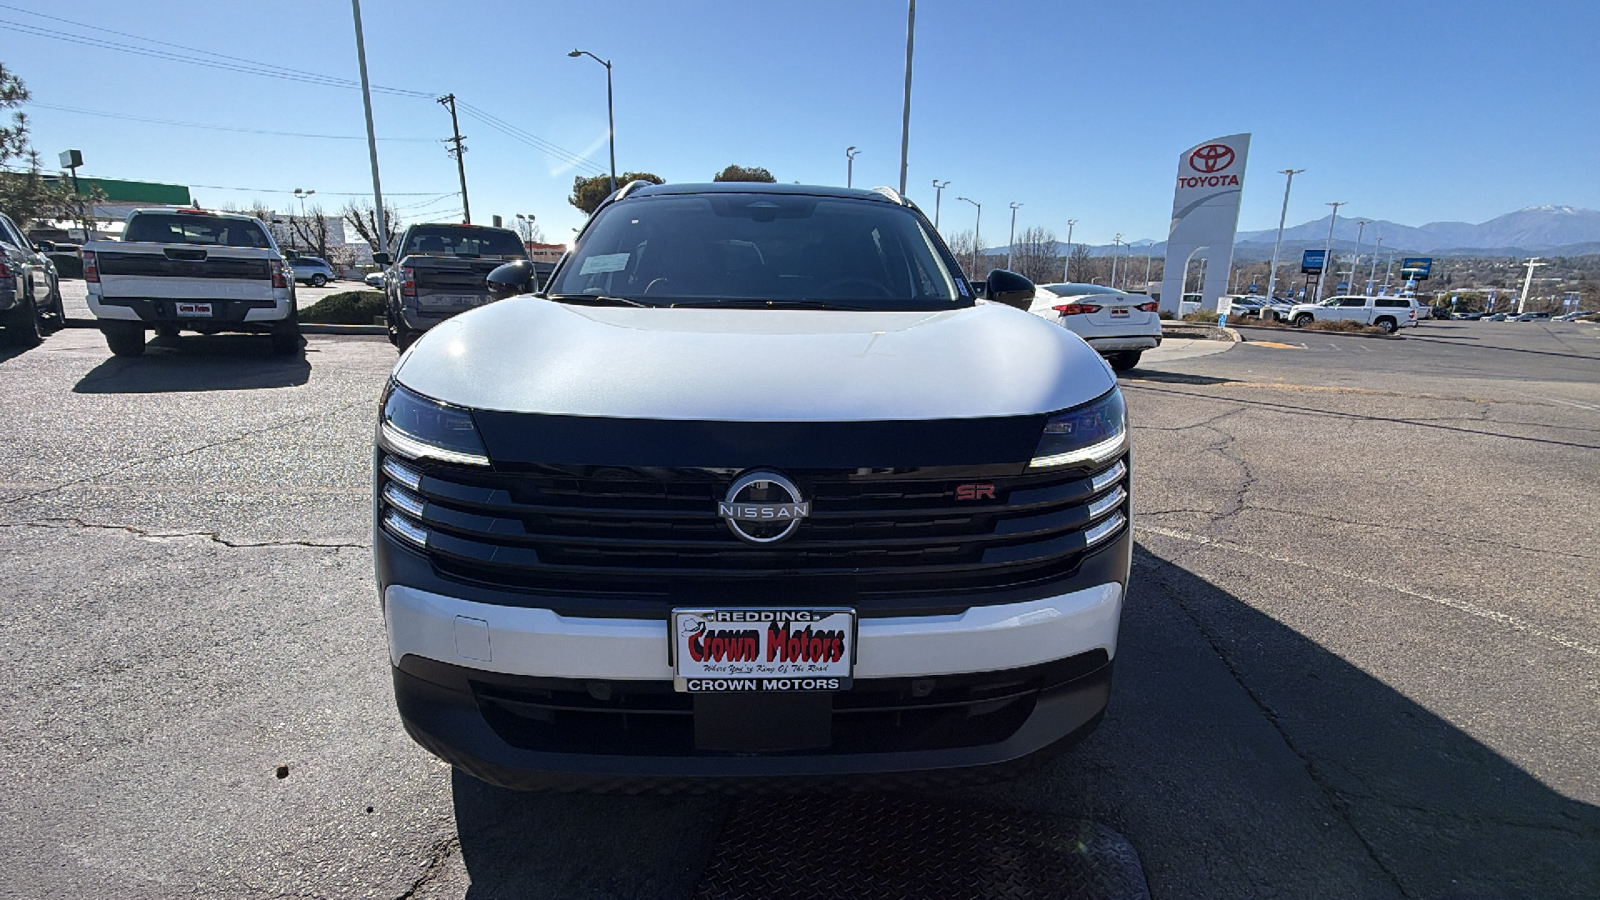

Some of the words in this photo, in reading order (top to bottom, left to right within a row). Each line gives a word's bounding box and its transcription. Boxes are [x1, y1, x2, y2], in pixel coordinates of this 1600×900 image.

[1179, 175, 1239, 188] TOYOTA
[957, 484, 995, 500] SR
[720, 504, 807, 518] NISSAN
[717, 612, 811, 621] REDDING
[688, 624, 760, 662] Crown
[766, 622, 845, 663] Motors
[703, 664, 727, 672] Where
[728, 664, 753, 675] You're
[756, 664, 775, 673] King
[778, 664, 788, 673] Of
[791, 664, 804, 672] The
[807, 664, 828, 672] Road
[688, 680, 756, 691] CROWN
[763, 678, 839, 690] MOTORS
